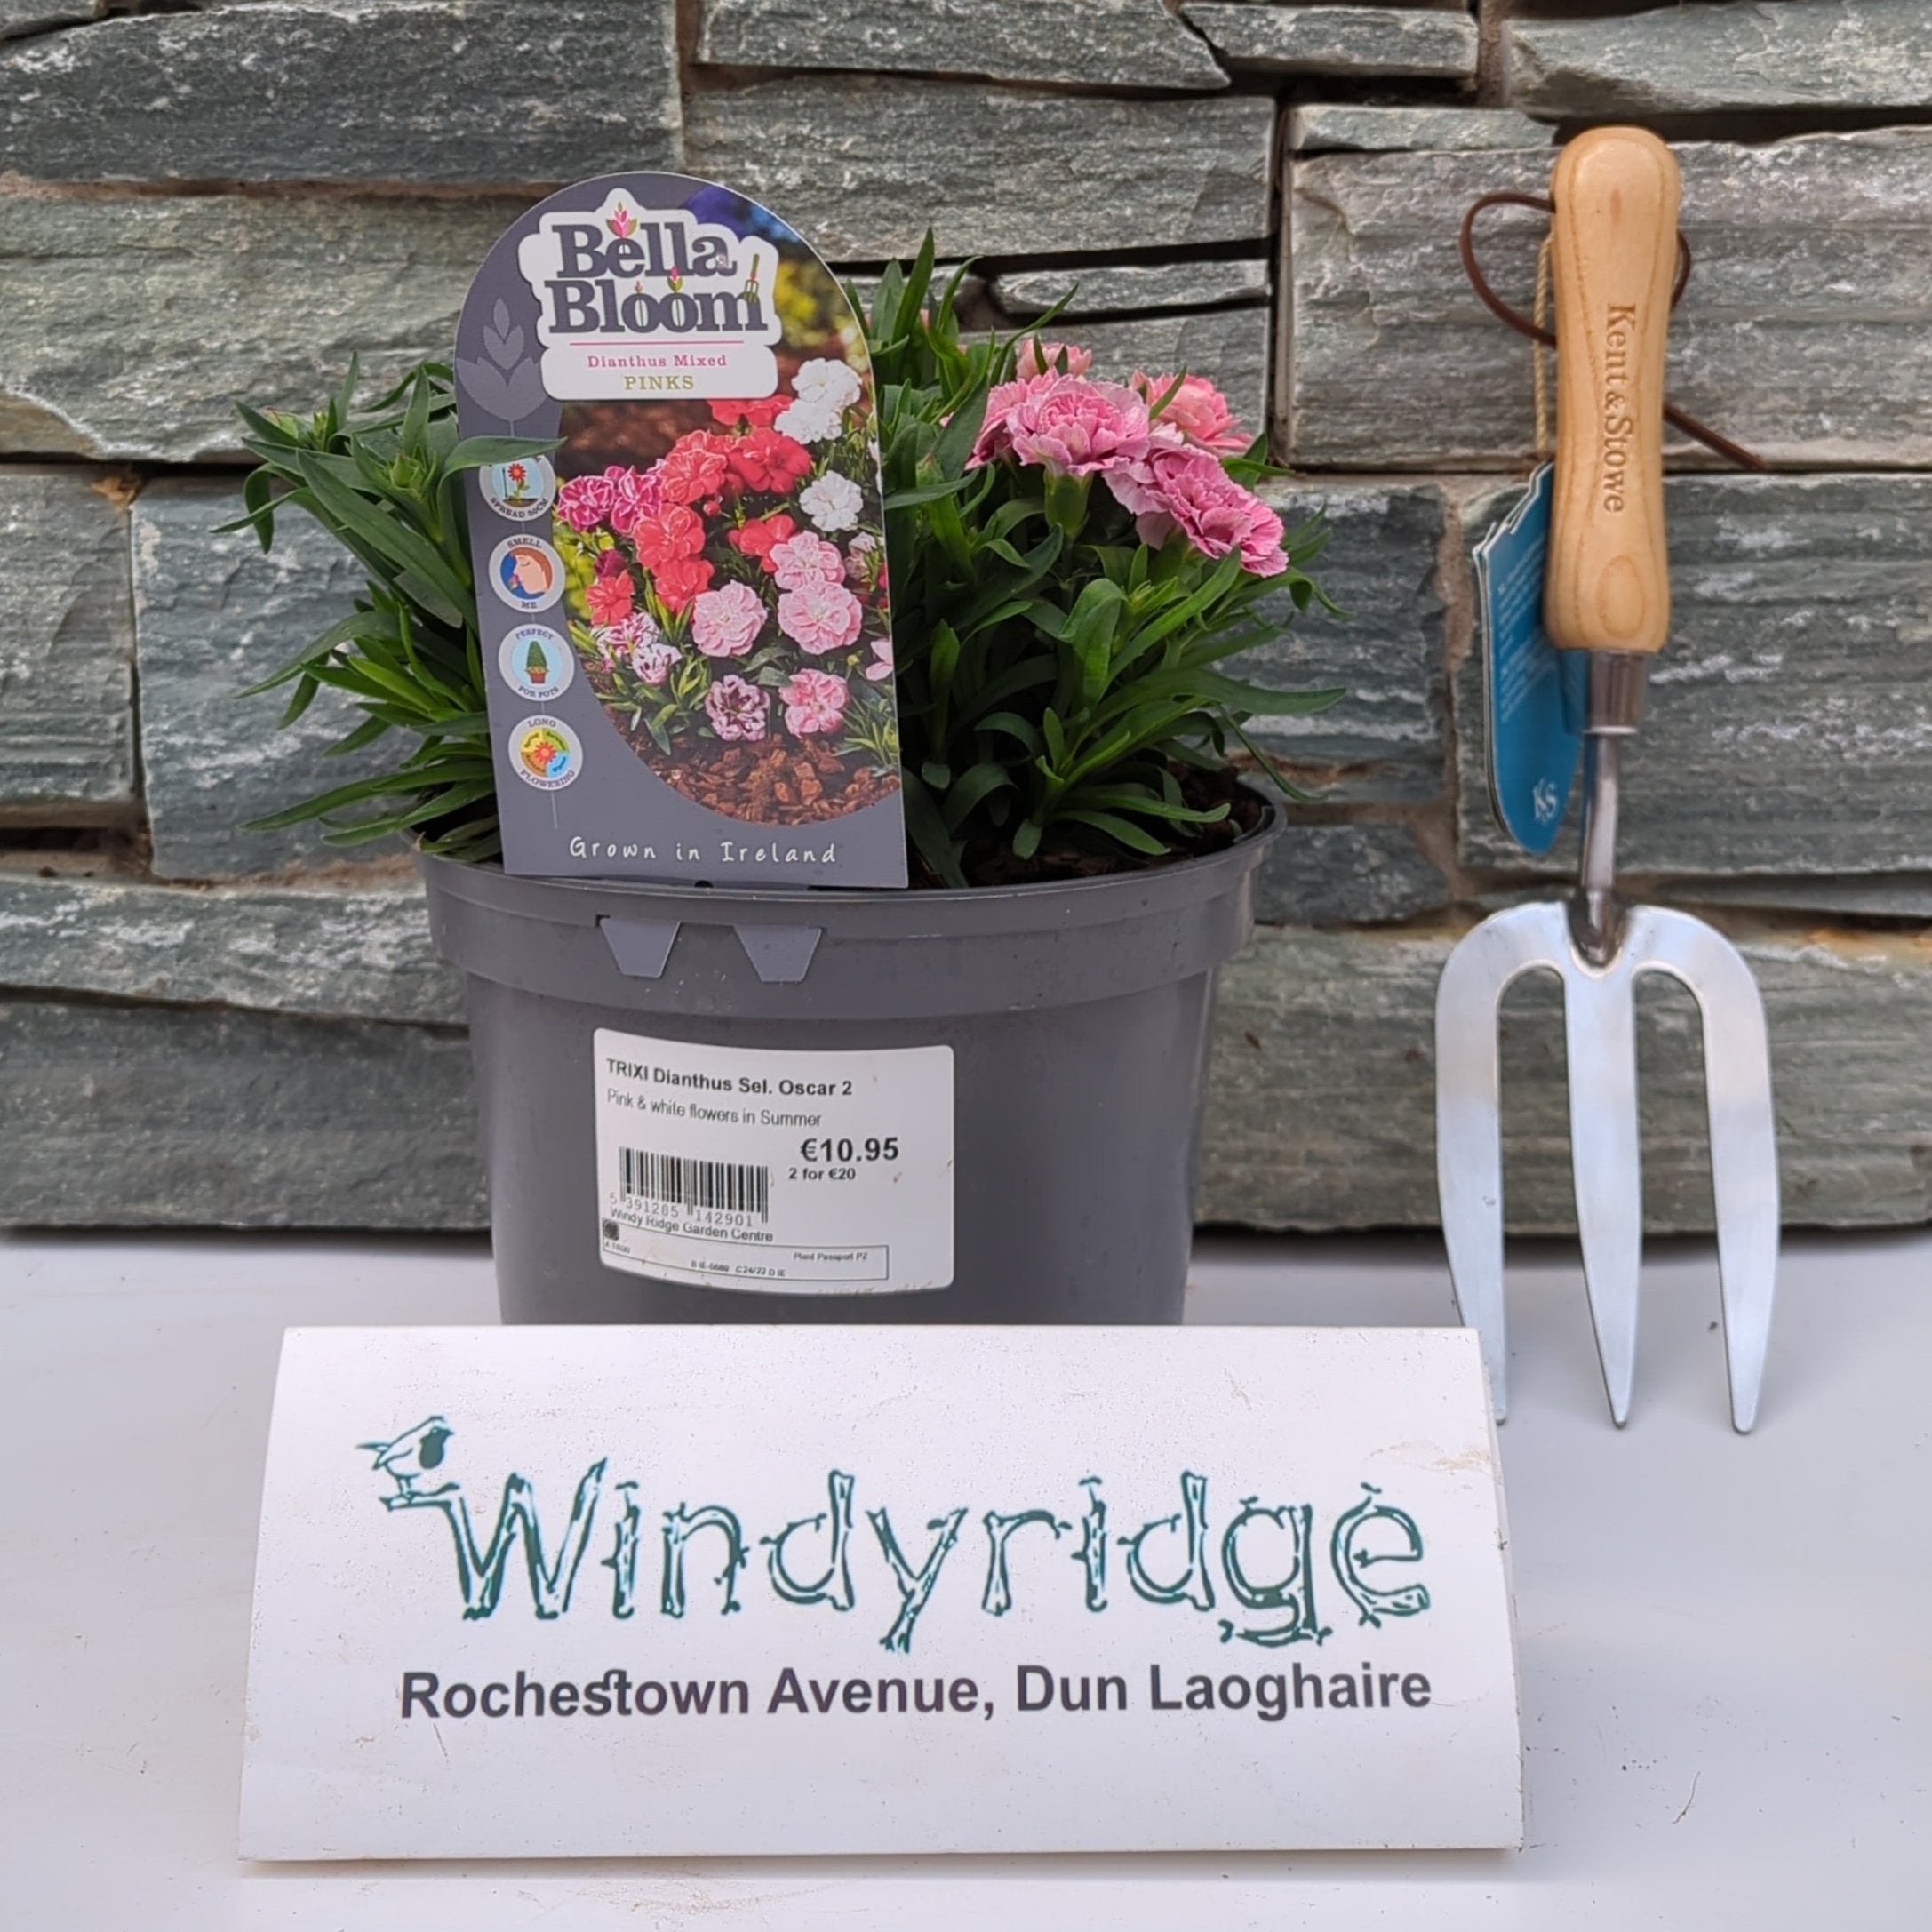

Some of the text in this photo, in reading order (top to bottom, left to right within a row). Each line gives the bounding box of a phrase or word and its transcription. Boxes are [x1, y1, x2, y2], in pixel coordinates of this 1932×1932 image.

[552, 222, 738, 278] Bella
[544, 279, 768, 333] Bloom
[587, 355, 727, 368] Dianthus Mixed
[624, 376, 694, 390] PINKS
[491, 498, 525, 518] SPREAD
[507, 537, 542, 549] SMELL
[515, 628, 555, 640] PERFECT
[517, 685, 560, 698] FOR POTS
[527, 718, 556, 728] LONG
[520, 770, 575, 788] FLOWERING
[569, 836, 835, 863] Grown in Ireland
[606, 1058, 853, 1097] TRIXI Dianthus Sel. Oscar 2
[607, 1089, 822, 1127] Pink & white flowers in Summer
[800, 1137, 899, 1162] €10.95
[788, 1167, 856, 1180] 2 for €20
[611, 1207, 773, 1242] Windy Ridge Garden Centre
[695, 1209, 754, 1227] 142901
[379, 1457, 1431, 1652] Windyridge
[401, 1662, 1432, 1722] Rochestown Avenue, Dun Laoghaire
